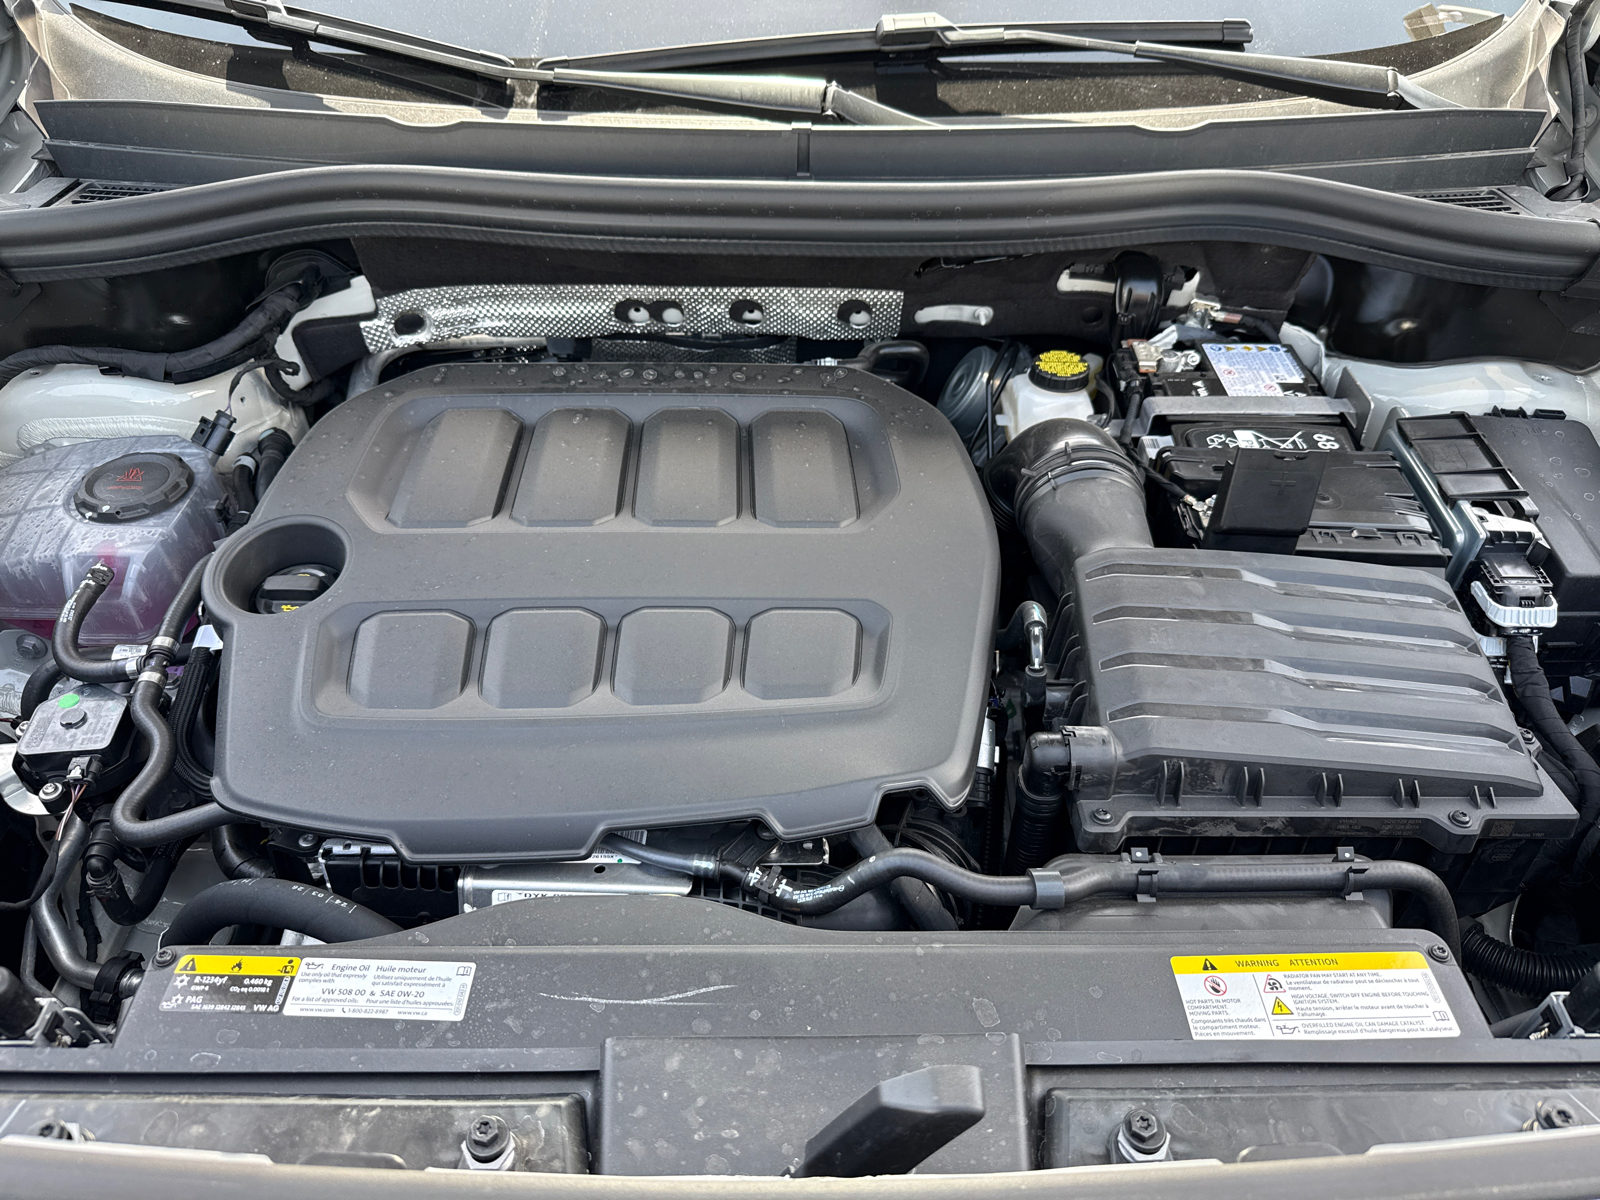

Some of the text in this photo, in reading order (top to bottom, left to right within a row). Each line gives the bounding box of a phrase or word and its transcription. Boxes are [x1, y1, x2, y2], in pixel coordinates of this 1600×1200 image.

[1290, 958, 1338, 966] ATTENTION
[331, 964, 357, 972] Engine
[194, 976, 228, 984] R-1234yf
[264, 978, 273, 986] kg
[397, 990, 425, 998] 0W-20
